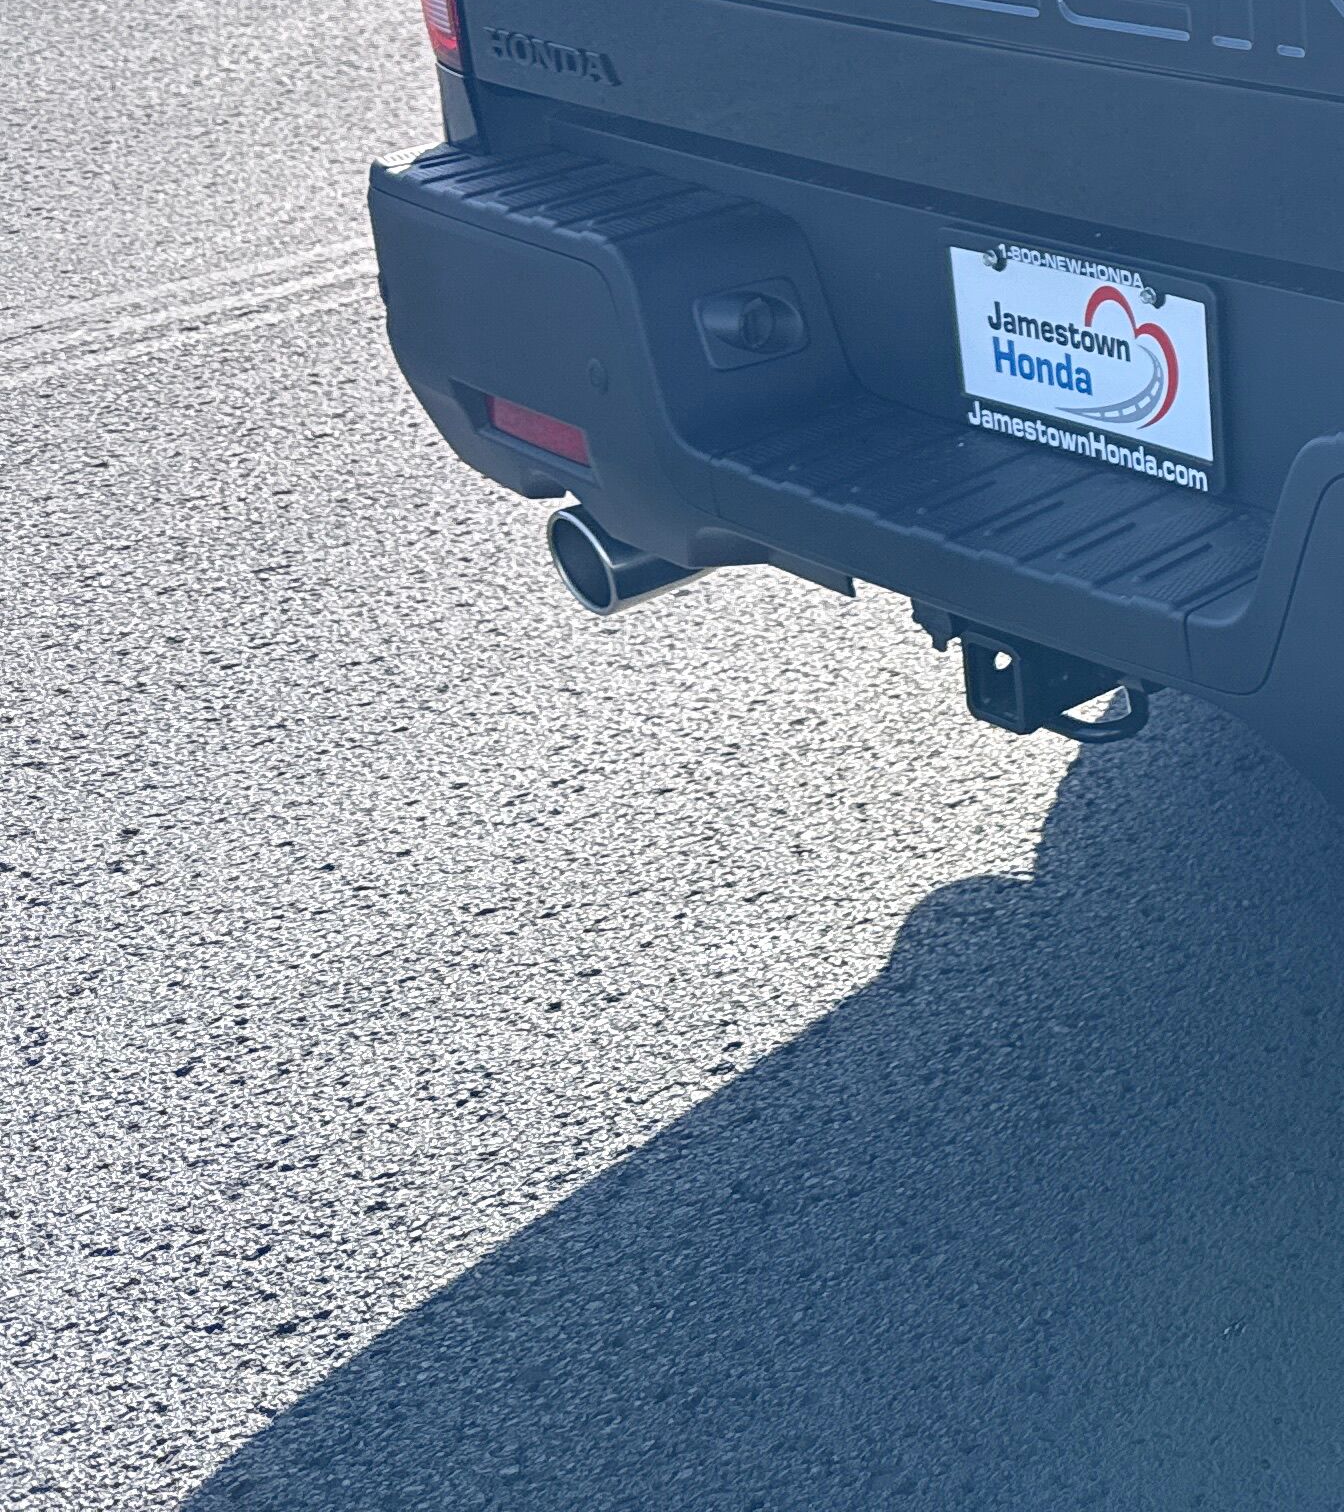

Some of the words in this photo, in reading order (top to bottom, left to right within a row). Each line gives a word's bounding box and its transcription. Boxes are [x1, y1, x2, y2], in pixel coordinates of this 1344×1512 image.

[481, 26, 622, 87] HONDA
[997, 243, 1145, 290] 1-800-NEW-HONDA
[987, 300, 1132, 363] Jamestown
[991, 336, 1094, 396] Honda
[967, 399, 1209, 493] JamestownHonda.com
